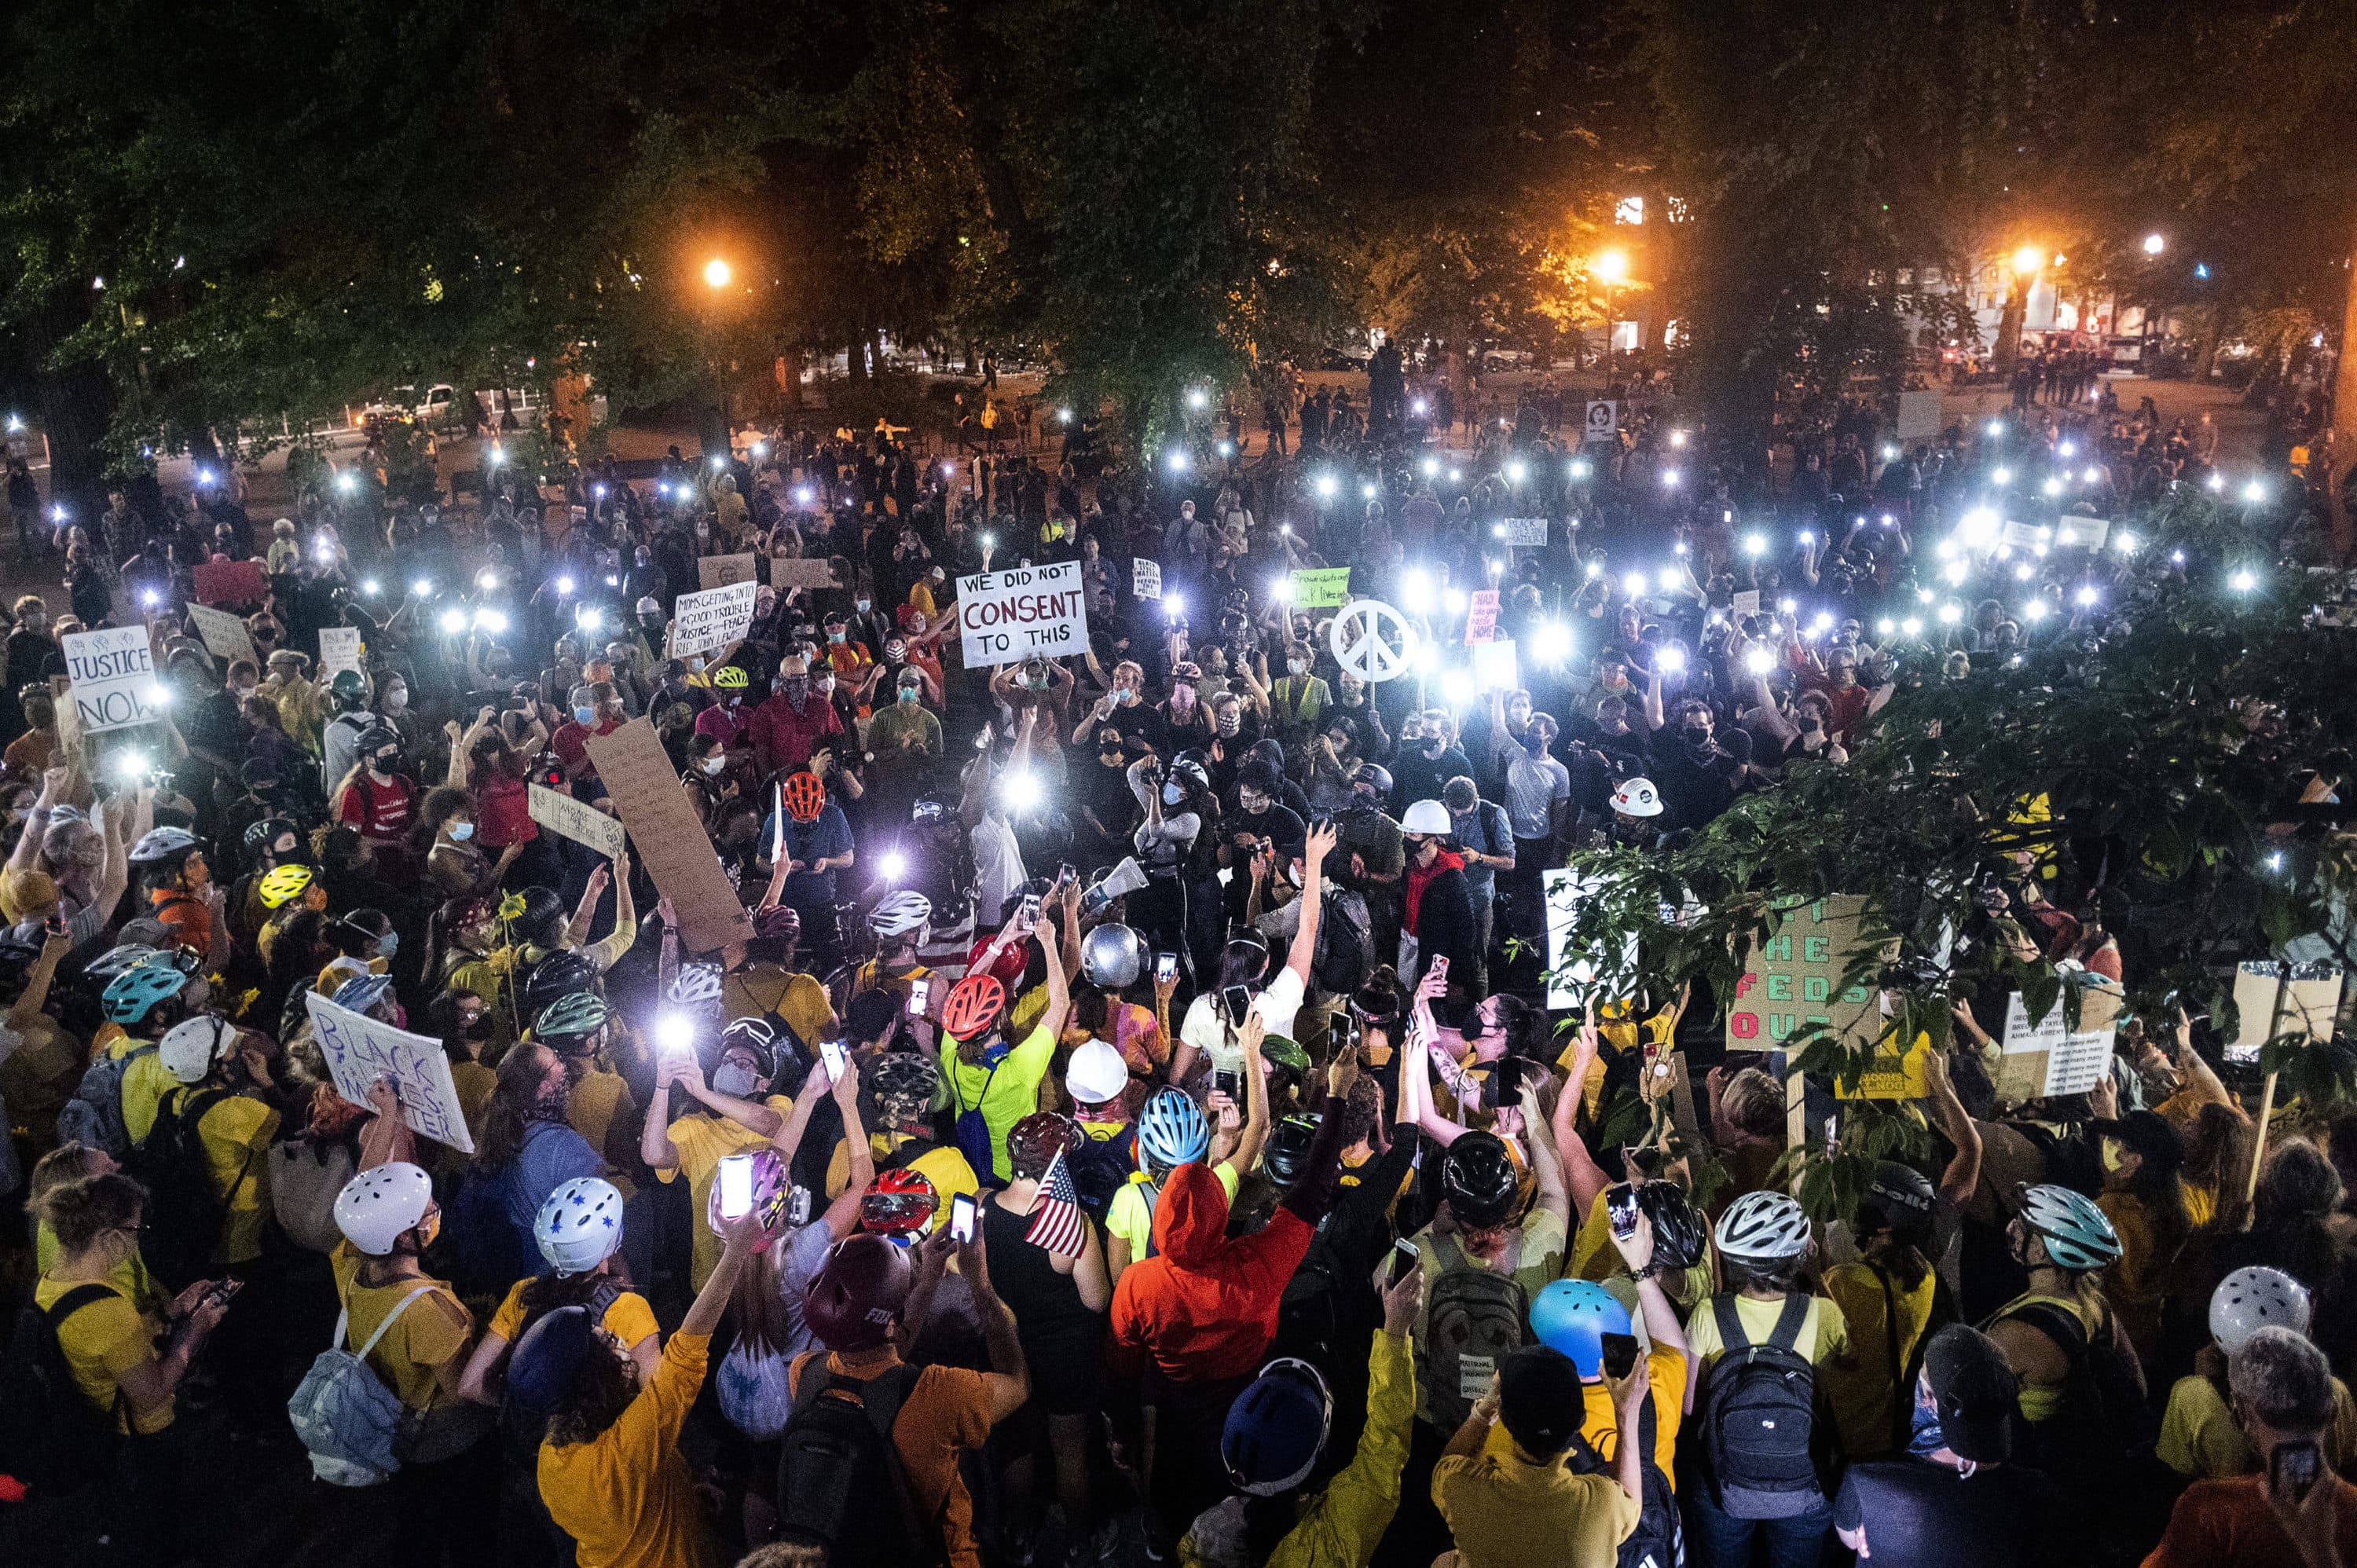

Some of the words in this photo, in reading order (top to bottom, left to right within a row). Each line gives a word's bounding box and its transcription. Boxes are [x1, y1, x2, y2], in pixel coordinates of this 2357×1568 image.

[964, 574, 994, 592] WE
[1004, 571, 1032, 588] DID
[1039, 565, 1072, 580] NOT
[678, 595, 701, 611] MOMS
[702, 590, 734, 607] GETTING
[714, 601, 750, 619] TROUBLE
[964, 590, 1082, 629] CONSENT
[676, 623, 713, 640] JUSTICE
[724, 614, 749, 630] PEACE
[977, 633, 1010, 654] TO
[1025, 624, 1070, 646] THIS
[676, 642, 692, 656] RIP
[694, 636, 715, 651] JOHN
[69, 648, 152, 680] JUSTICE
[1765, 936, 1830, 962] HE
[1736, 973, 1869, 1004] FEDS
[317, 1013, 435, 1087] BLACK
[338, 1070, 456, 1142] MTER
[864, 1307, 894, 1324] FOX
